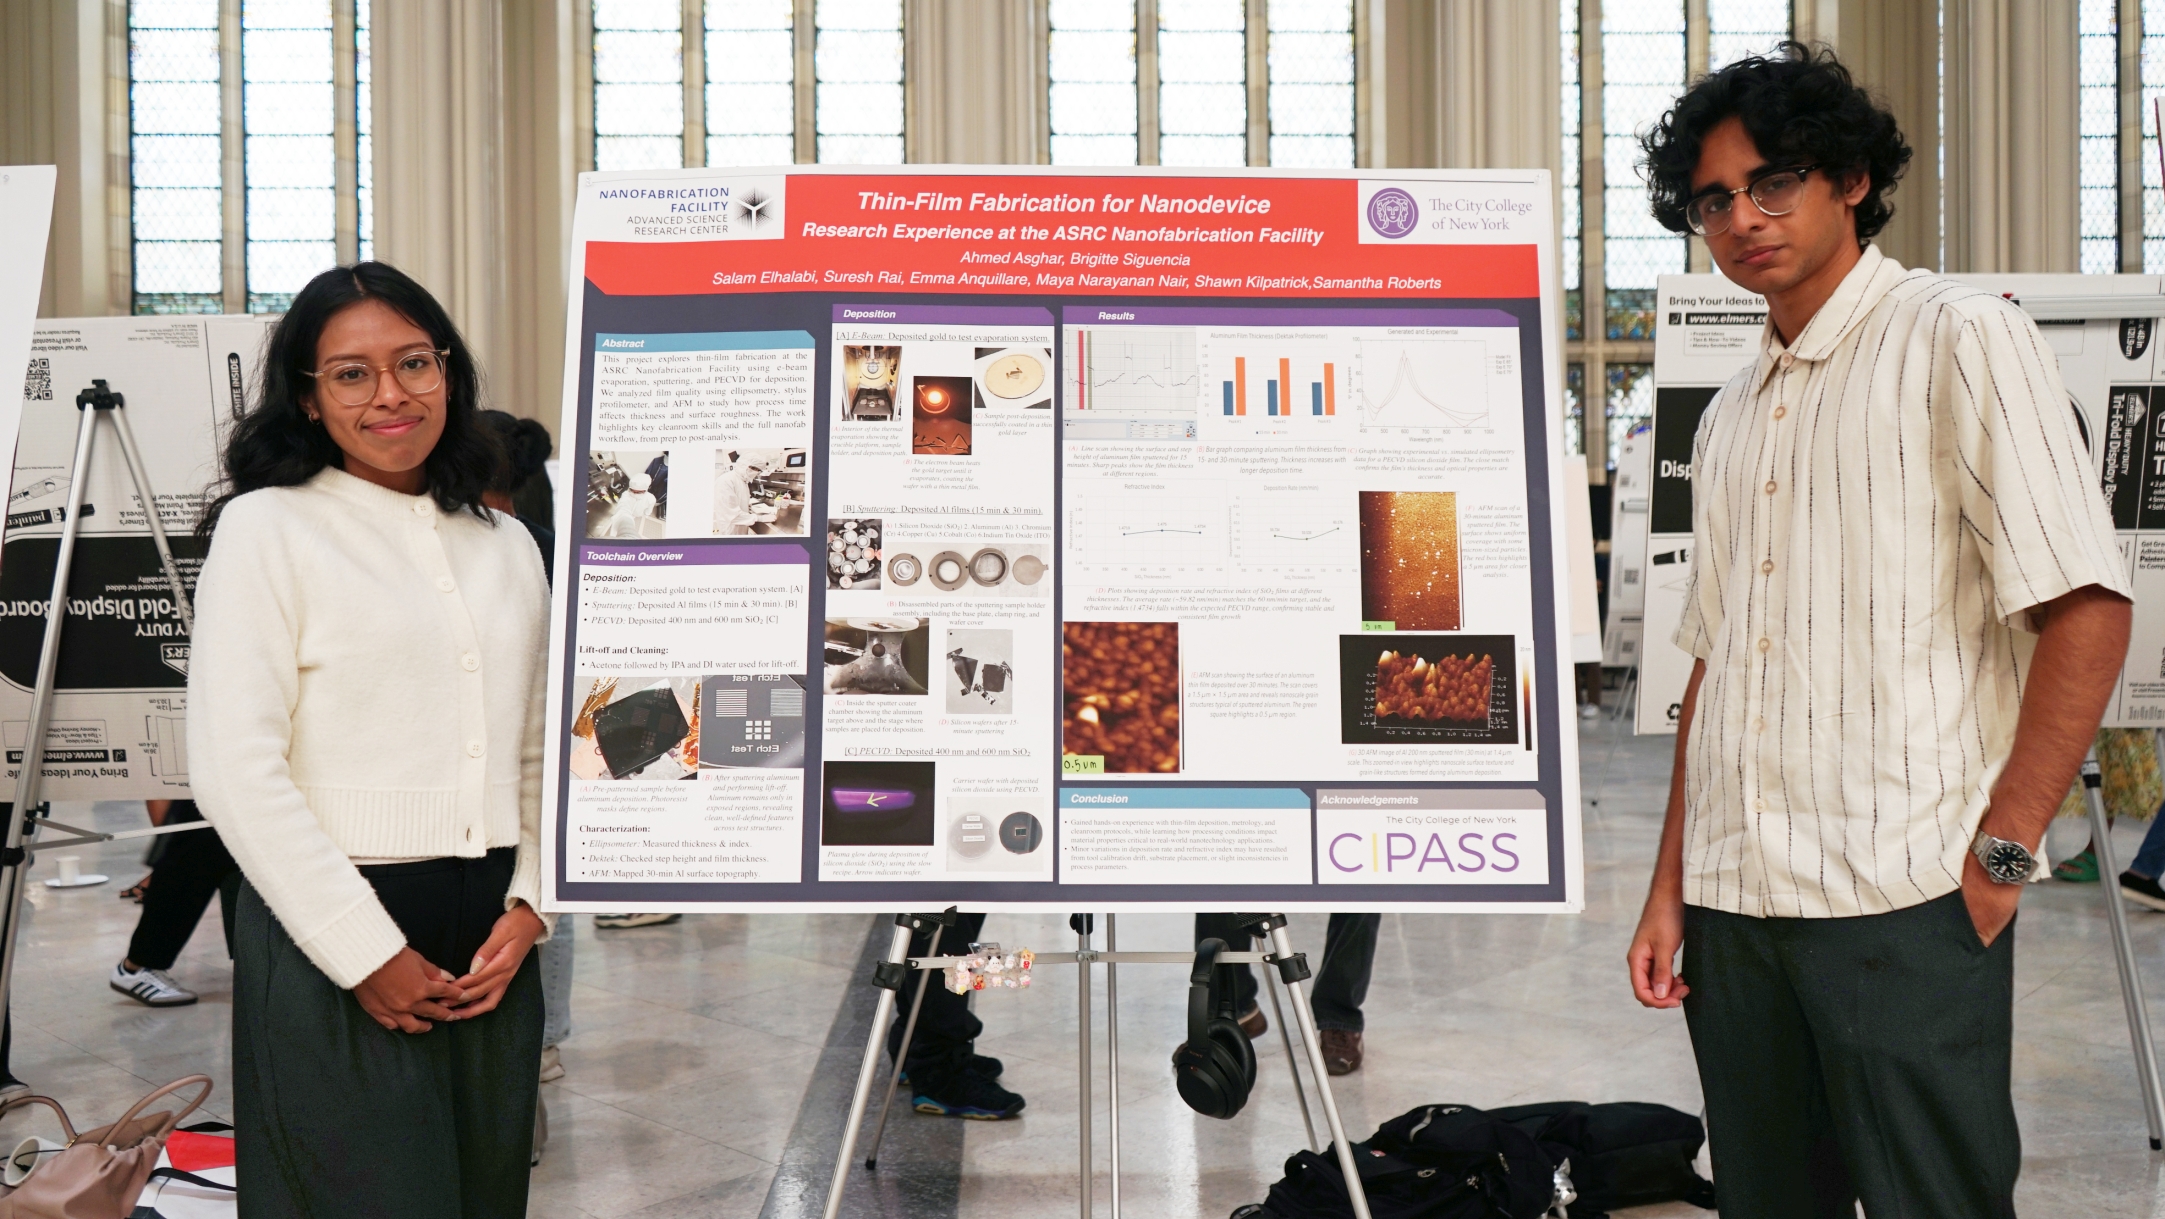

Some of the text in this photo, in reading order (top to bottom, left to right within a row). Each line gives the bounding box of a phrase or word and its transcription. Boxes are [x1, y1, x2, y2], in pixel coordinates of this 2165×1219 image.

[600, 187, 729, 199] NANOFABRICATION
[671, 201, 729, 213] FACILITY
[858, 191, 1270, 214] Thin-Film Fabrication for Nanodevice
[1429, 198, 1532, 215] The City College
[627, 214, 728, 225] ADVANCED SCIENCE
[1431, 216, 1509, 229] of New York
[634, 225, 729, 236] RESEARCH CENTER
[802, 222, 1323, 246] Research Experience at the ASRC Nanofabrication Facility
[960, 251, 1190, 268] Ahmed Asghar, Brigitte Siguencia
[712, 272, 756, 284] Salam
[760, 270, 817, 283] Elhalabi,
[823, 269, 873, 282] Suresh
[877, 270, 903, 284] Rai,
[909, 271, 954, 284] Emma
[957, 272, 1030, 287] Anquillare,
[1036, 273, 1074, 288] Maya
[1078, 274, 1154, 289] Narayanan
[1158, 274, 1188, 288] Nair,
[1194, 274, 1241, 287] Shawn
[1387, 276, 1441, 289] Roberts
[1669, 296, 1765, 306] Bring Your Ideas to
[843, 310, 896, 320] Deposition
[1098, 312, 1135, 321] Results
[888, 332, 926, 341] Deposited
[929, 332, 946, 341] gold
[948, 332, 956, 341] to
[958, 332, 971, 342] test
[974, 333, 1018, 342] evaporation
[602, 339, 645, 348] Abstract
[602, 354, 619, 362] This
[658, 355, 690, 363] explores
[696, 353, 729, 361] thin-film
[230, 358, 241, 388] INSIDE
[635, 366, 701, 374] Nanofabrication
[709, 364, 739, 373] Facility
[2104, 440, 2120, 483] Display
[2121, 454, 2130, 475] DUTY
[587, 551, 683, 560] Toolchain Overview
[584, 573, 636, 583] Deposition:
[135, 623, 172, 636] DUTY
[579, 645, 610, 653] Lift-off
[1064, 759, 1081, 772] 0.5
[41, 767, 128, 778] Bring Your Ideas
[1071, 794, 1128, 804] Conclusion
[1321, 796, 1419, 806] Acknowledgements
[1405, 816, 1423, 825] City
[1425, 816, 1459, 825] College
[579, 825, 650, 833] Characterization:
